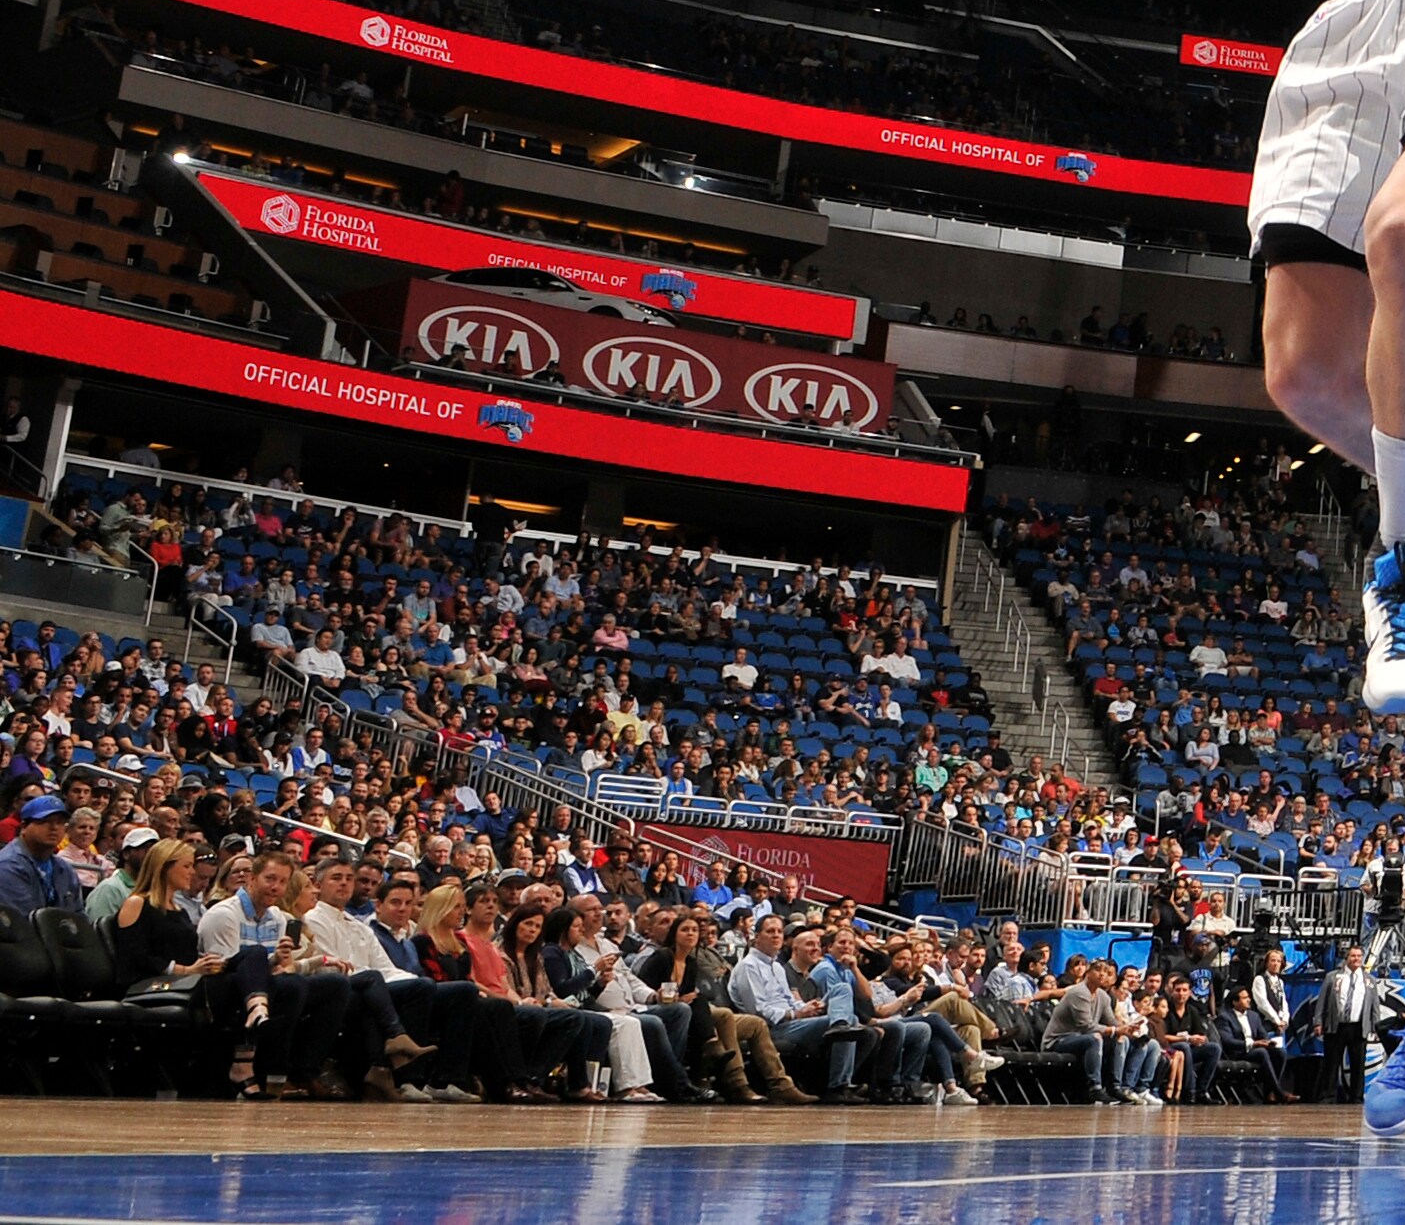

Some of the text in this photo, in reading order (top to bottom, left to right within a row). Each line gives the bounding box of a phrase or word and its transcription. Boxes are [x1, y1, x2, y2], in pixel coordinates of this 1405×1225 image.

[391, 37, 454, 63] HOSPITAL
[394, 25, 448, 50] FLORIDA
[1219, 54, 1271, 71] HOSPITAL
[1220, 45, 1265, 61] FLORIDA
[881, 129, 947, 152] OFFICIAL
[951, 139, 1021, 164] HOSPITAL
[1026, 152, 1045, 167] OF
[304, 205, 375, 234] FLORIDA
[302, 220, 382, 252] HOSPITAL
[548, 266, 607, 286] HOSPITAL
[610, 275, 628, 287] OF
[440, 317, 534, 373] KIA
[605, 346, 698, 399] KIA
[243, 362, 331, 397] OFFICIAL
[338, 381, 431, 416] HOSPITAL
[437, 400, 464, 420] OF
[766, 377, 852, 419] KIA
[737, 843, 811, 868] FLORIDA
